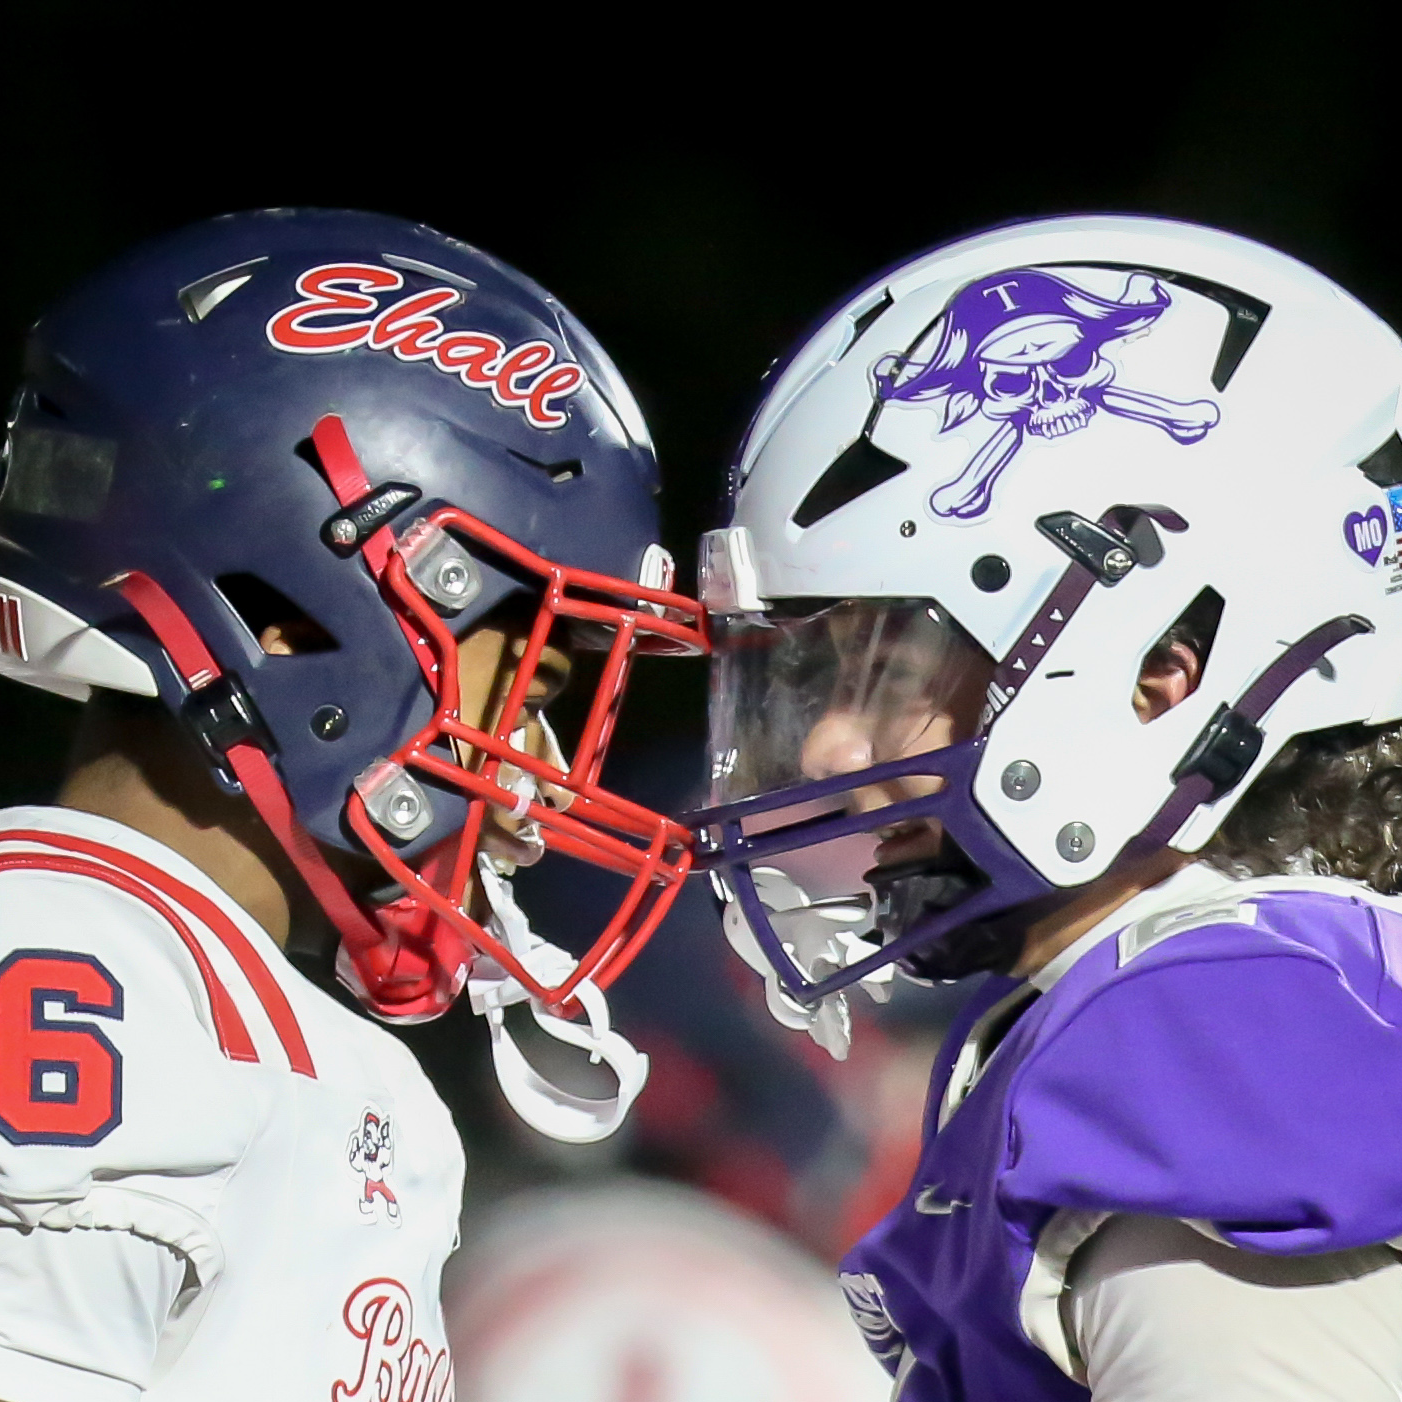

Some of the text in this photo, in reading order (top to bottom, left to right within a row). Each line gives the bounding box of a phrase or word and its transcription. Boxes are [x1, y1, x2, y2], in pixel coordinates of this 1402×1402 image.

[982, 281, 1021, 312] T
[266, 263, 586, 429] Ehall
[1353, 517, 1383, 552] MO
